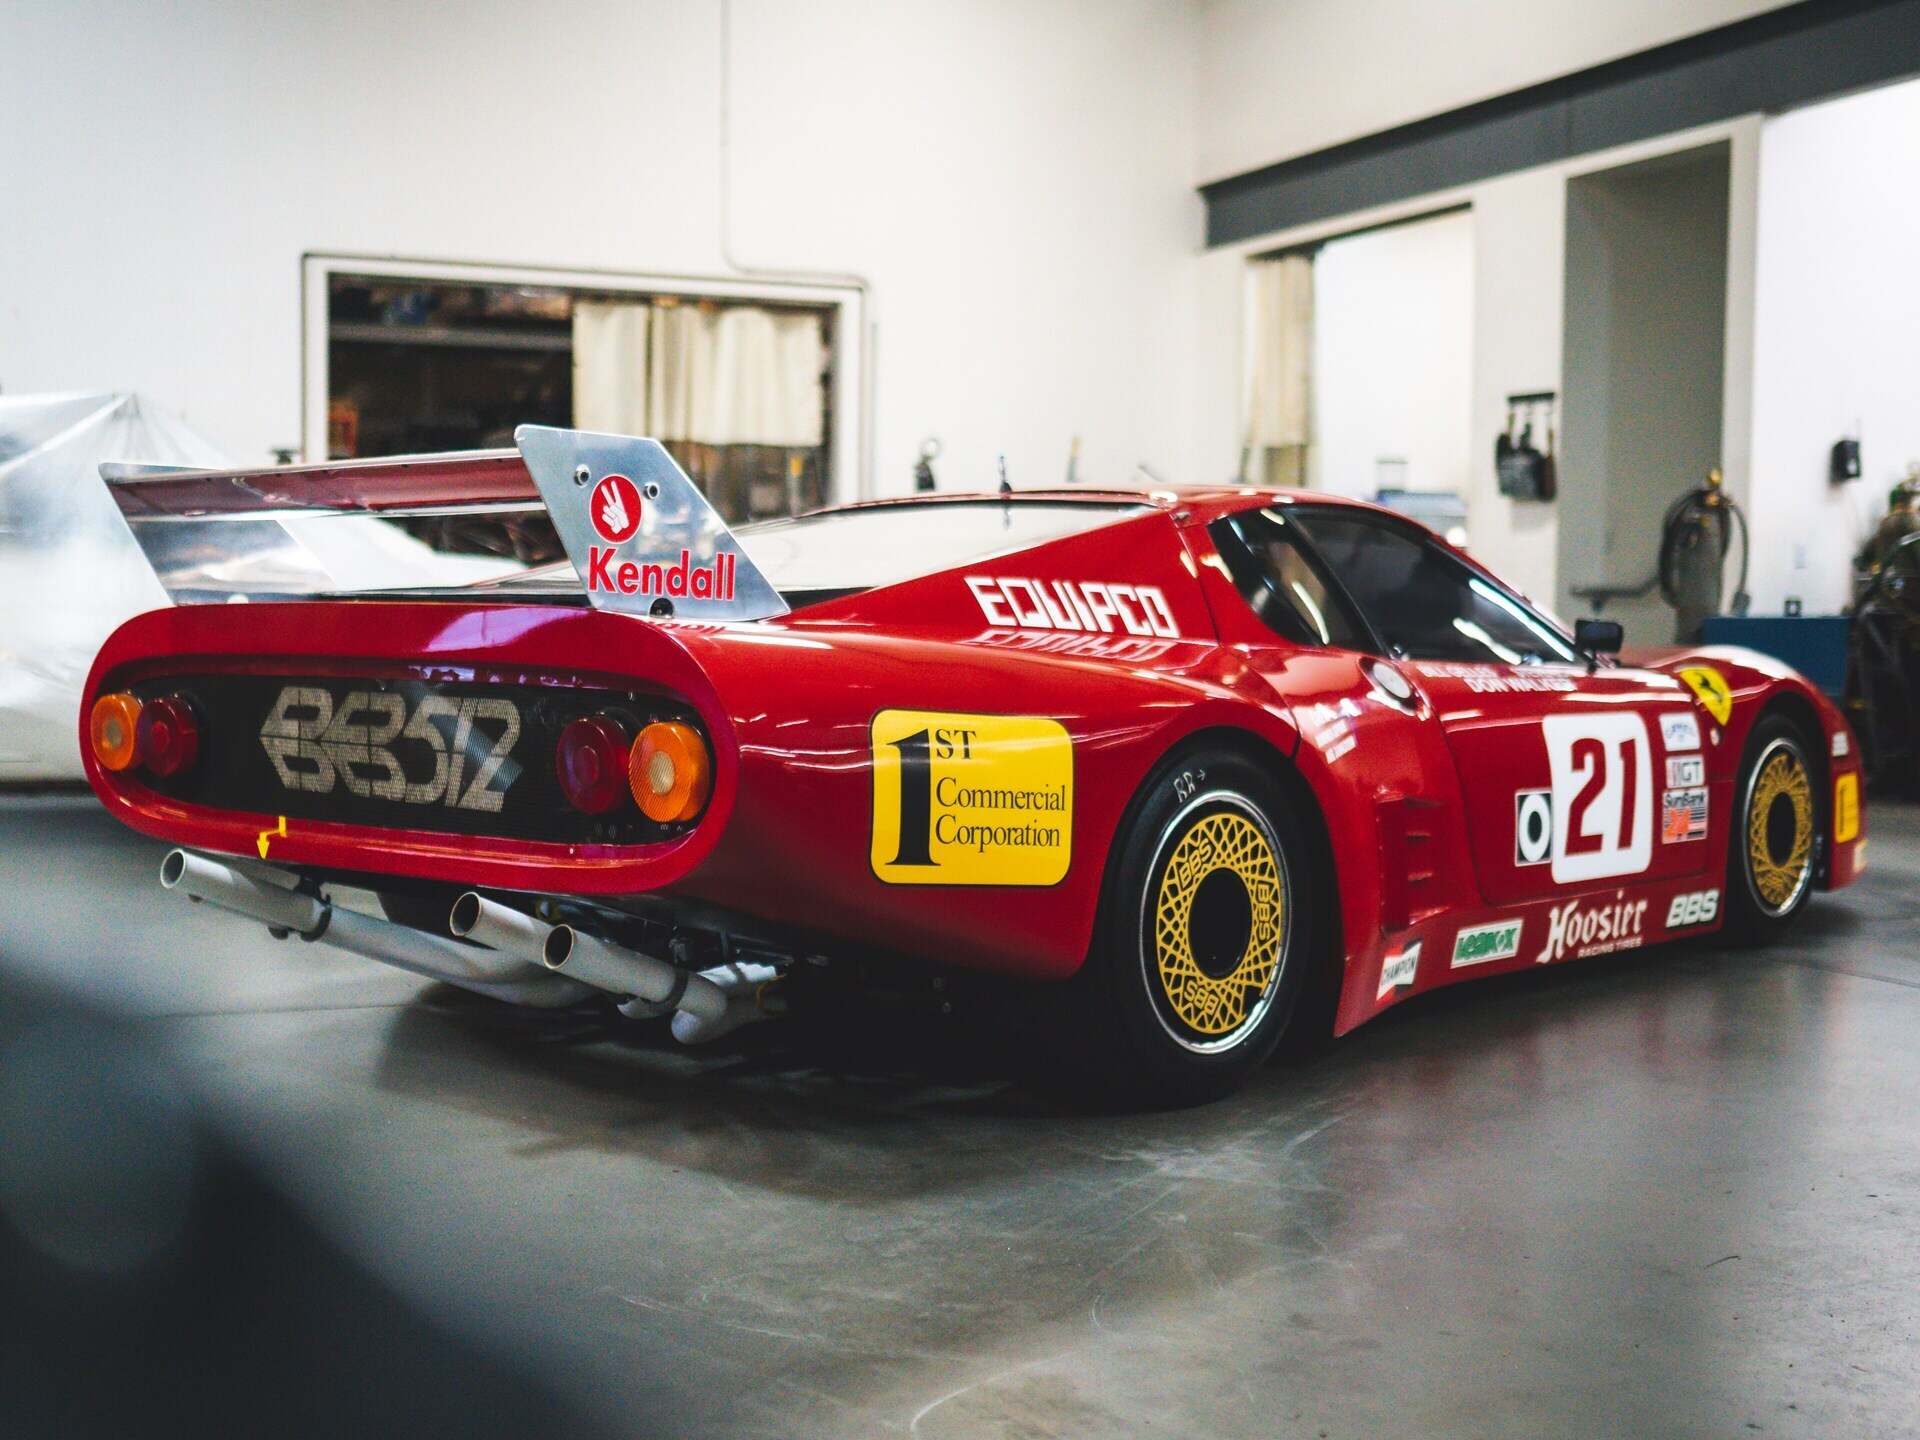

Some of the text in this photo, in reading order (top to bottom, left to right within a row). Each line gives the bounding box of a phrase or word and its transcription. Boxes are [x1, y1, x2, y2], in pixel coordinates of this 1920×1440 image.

[587, 545, 736, 601] Kendall
[964, 575, 1181, 639] EQUIPCO
[259, 686, 521, 813] BB512
[936, 777, 1066, 811] Commercial
[1564, 737, 1637, 856] 21
[935, 814, 1060, 853] Corporation
[1178, 837, 1216, 888] BBS
[1257, 882, 1272, 942] BBS
[1535, 889, 1648, 964] Hoosier
[1665, 889, 1720, 928] BBS
[1183, 982, 1221, 1016] BBS
